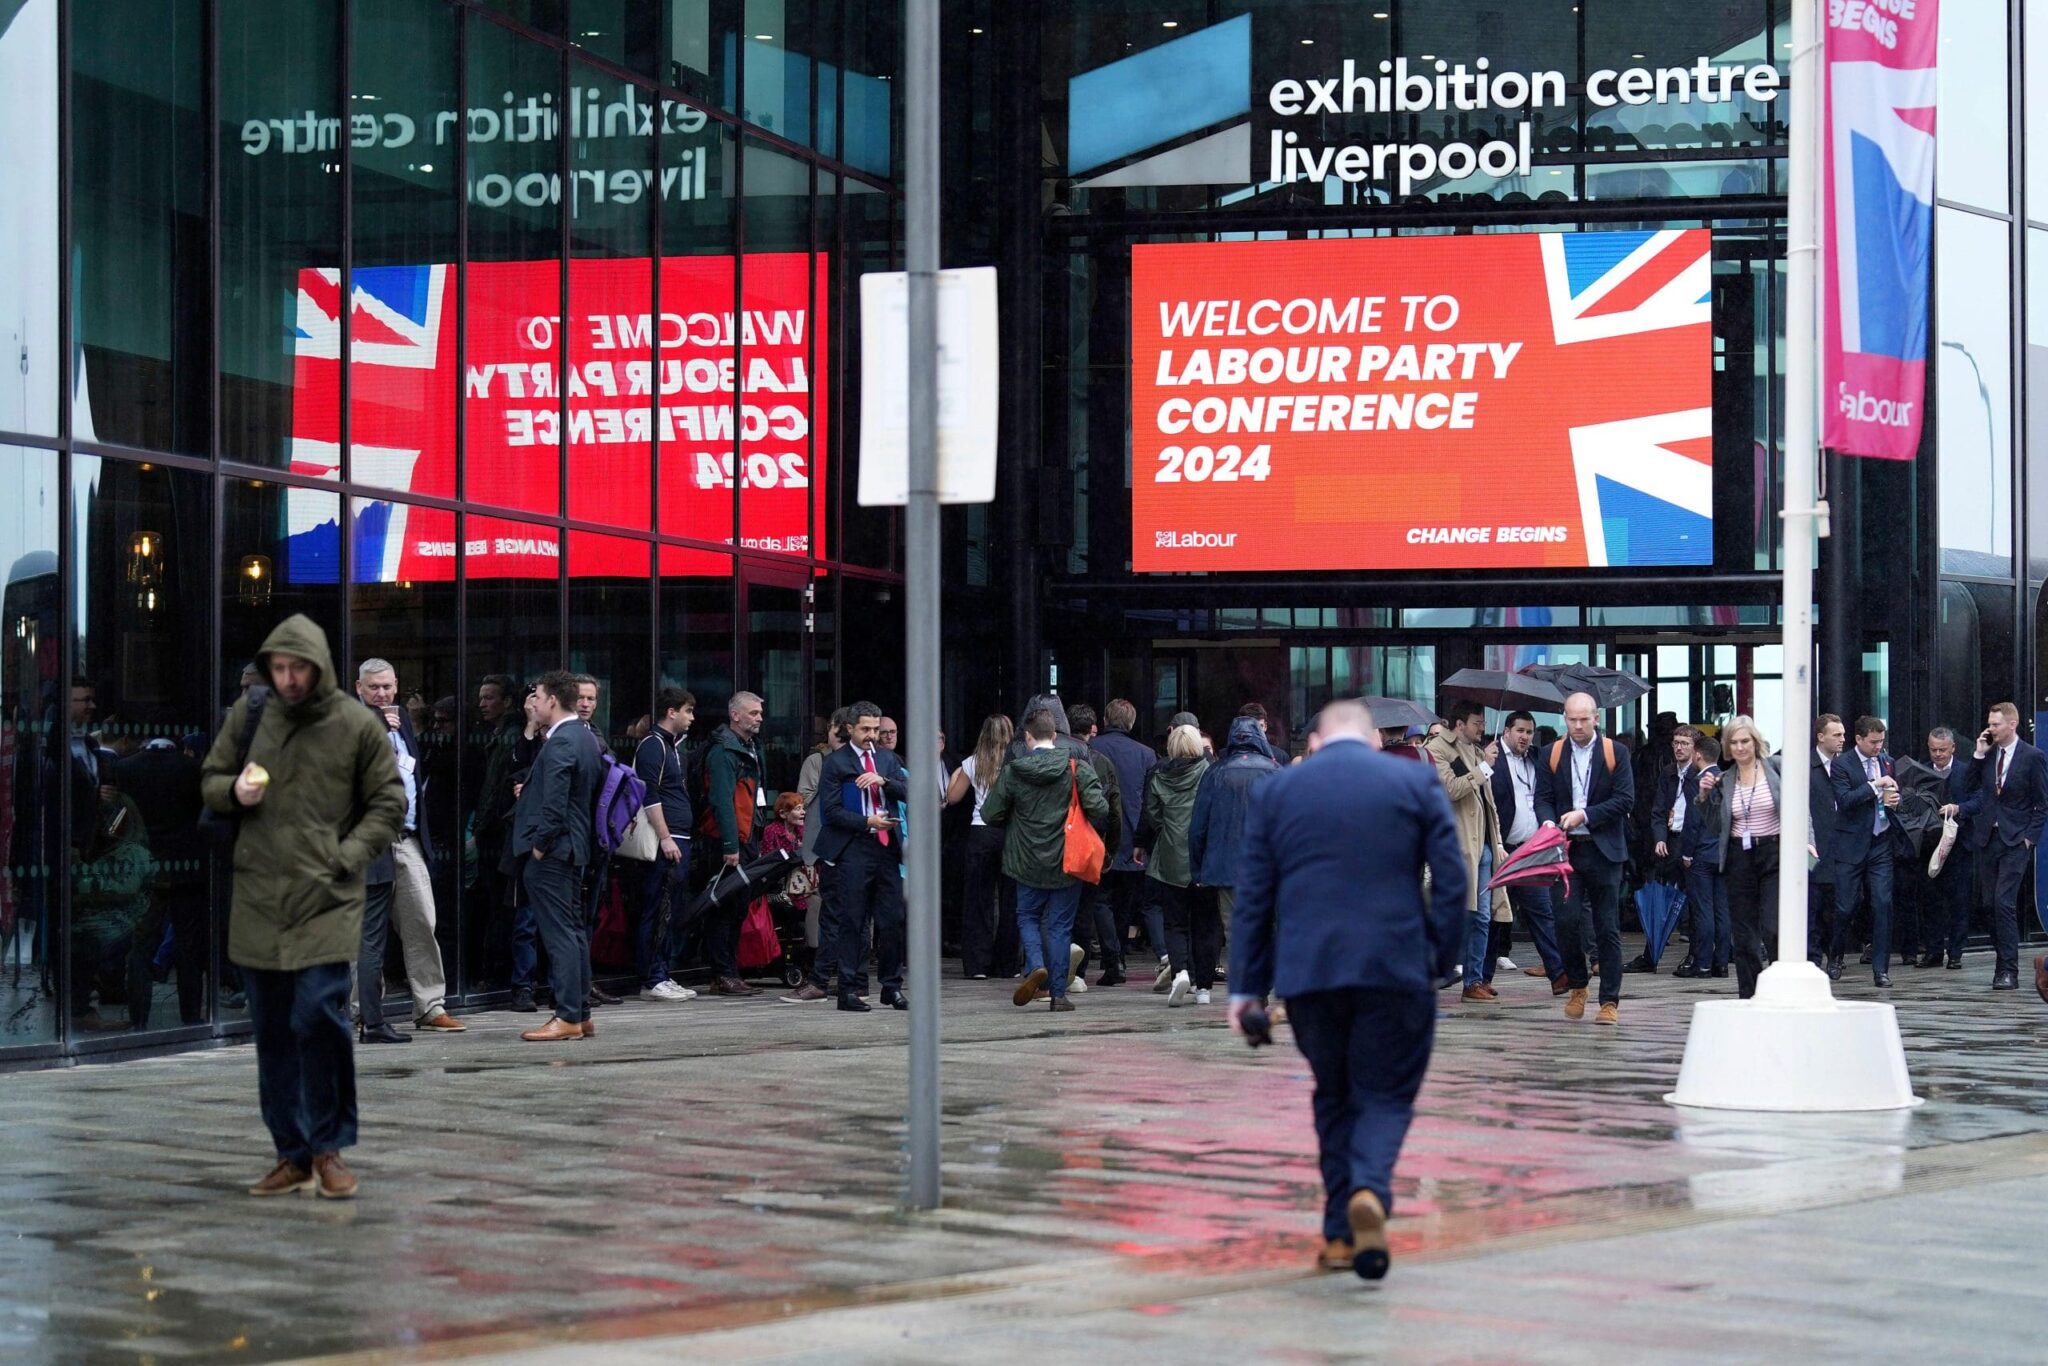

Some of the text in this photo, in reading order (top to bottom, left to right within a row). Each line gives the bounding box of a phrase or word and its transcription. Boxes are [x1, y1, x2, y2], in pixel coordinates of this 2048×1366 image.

[1269, 54, 1780, 116] exhibition centre
[1270, 121, 1531, 196] liverpool
[1159, 294, 1460, 338] WELCOME TO
[1155, 342, 1523, 386] LABOUR PARTY
[1156, 392, 1479, 434] CONFERENCE
[1841, 389, 1914, 427] abour
[1154, 444, 1271, 483] 2024
[1172, 531, 1238, 548] Labour
[1406, 526, 1568, 544] CHANGE BEGINS
